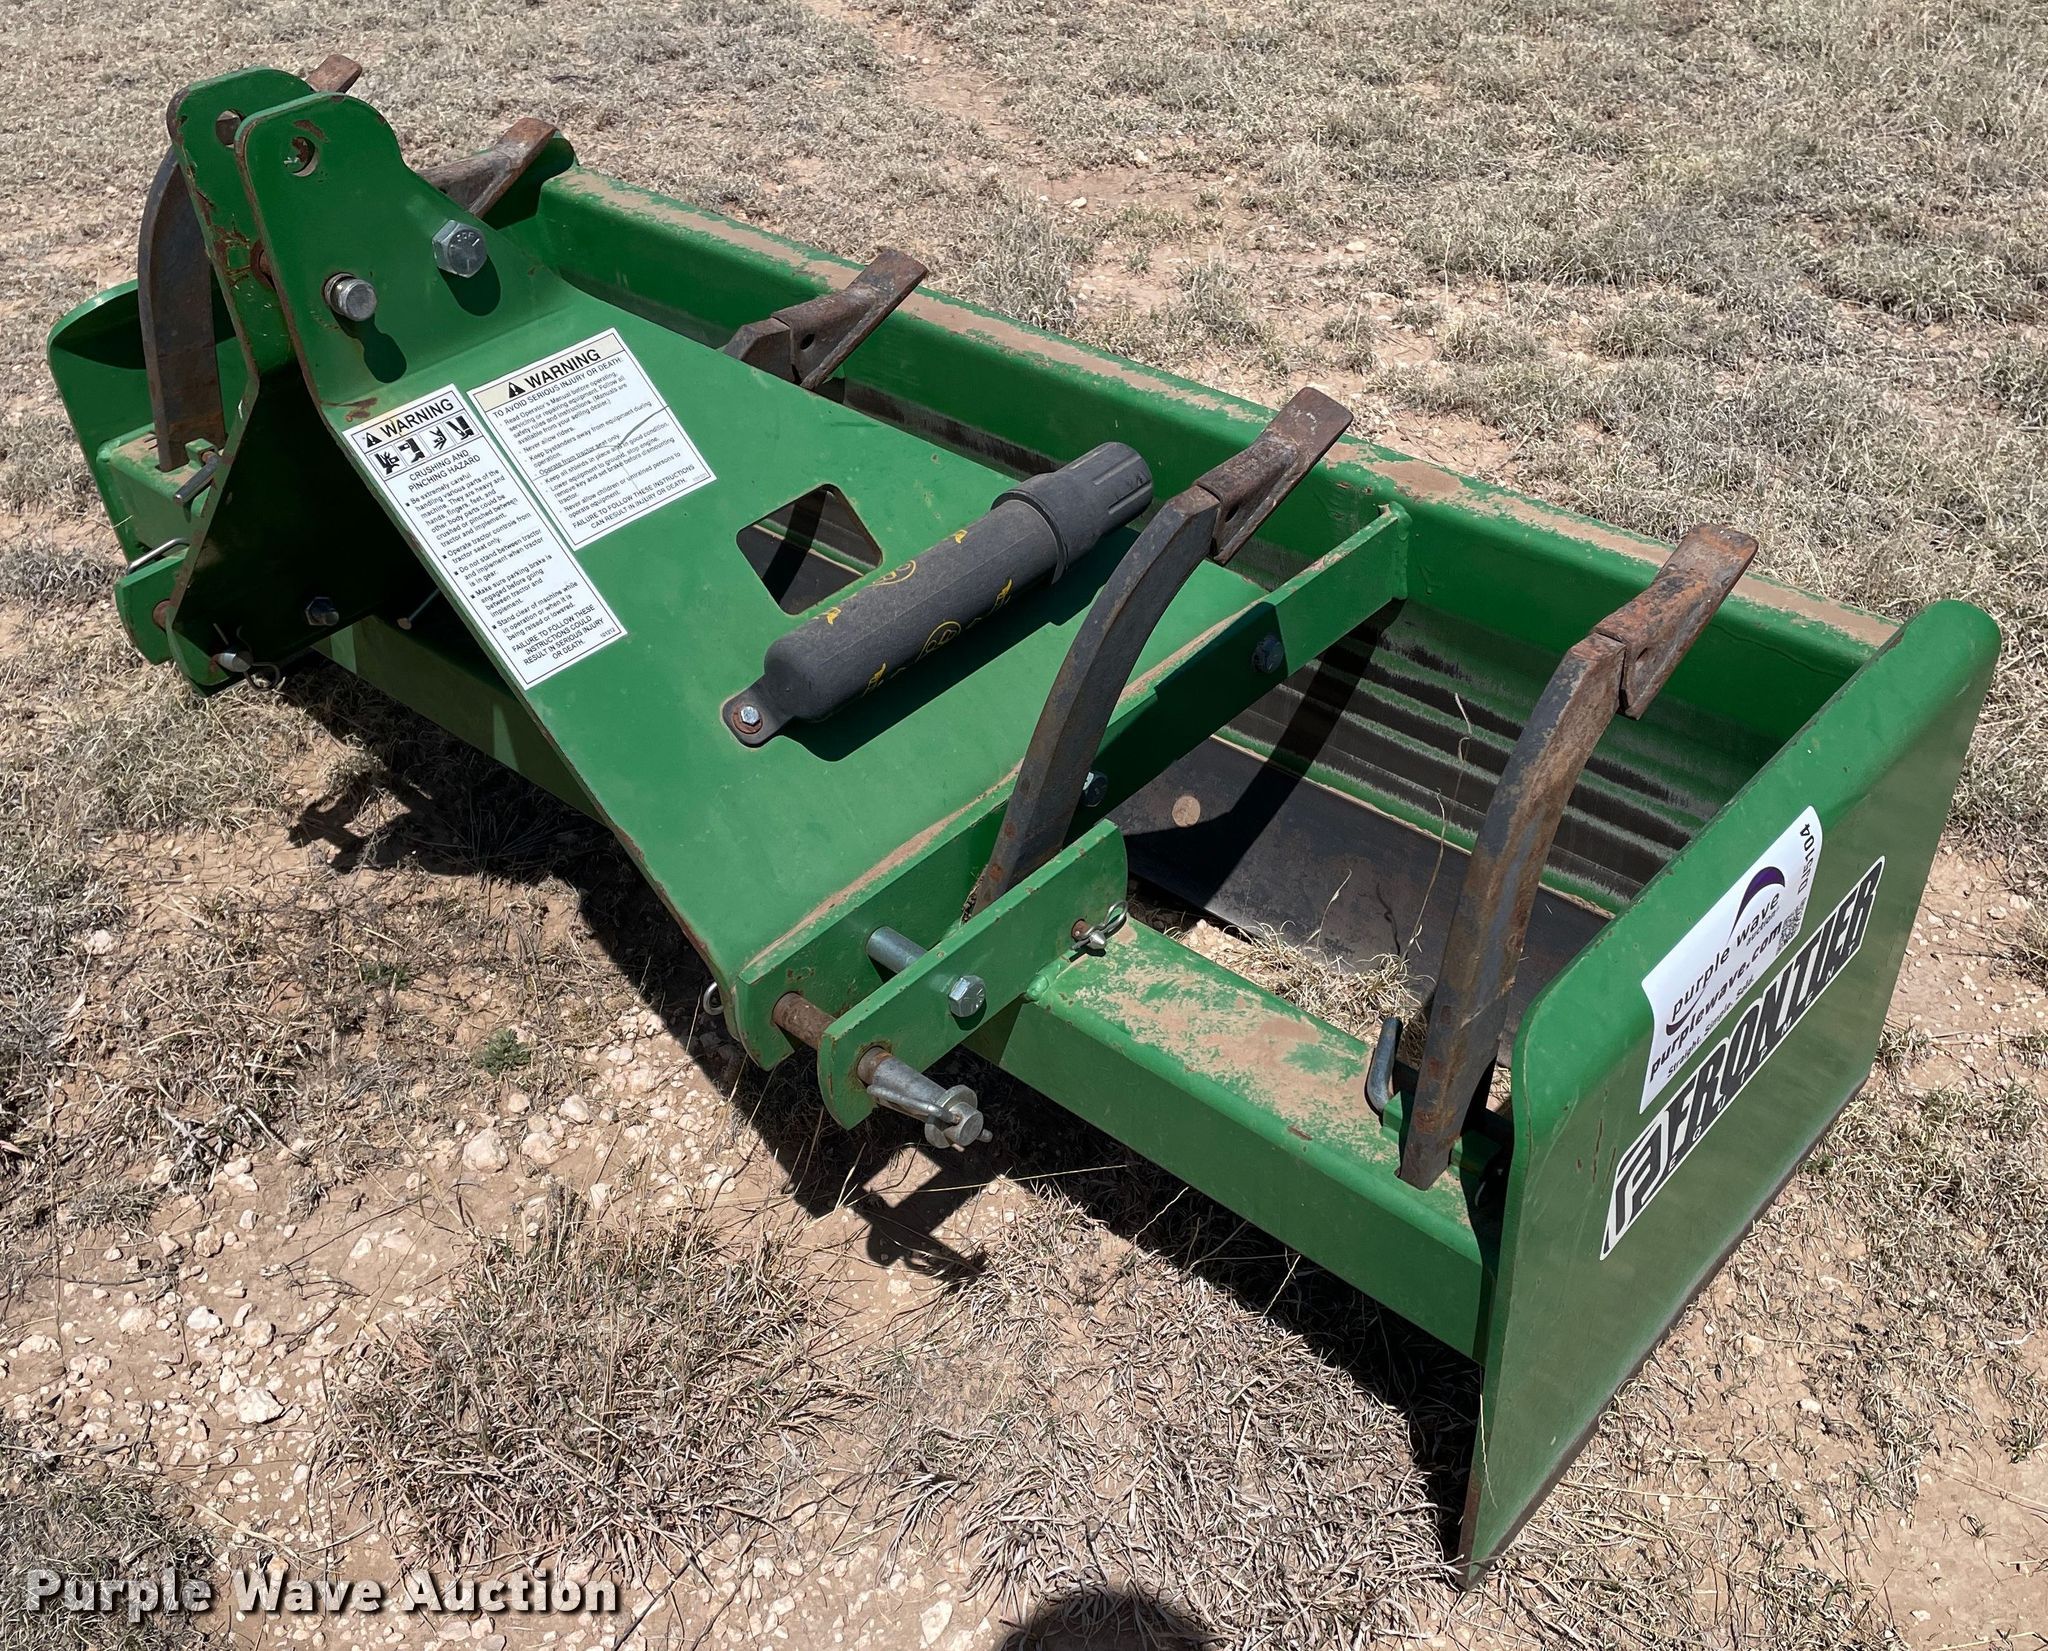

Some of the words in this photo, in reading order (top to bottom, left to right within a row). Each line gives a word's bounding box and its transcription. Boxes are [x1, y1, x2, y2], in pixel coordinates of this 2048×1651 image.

[523, 348, 601, 389] WARNING
[492, 409, 504, 418] TO
[504, 398, 527, 413] AVOID
[526, 384, 560, 403] SERIOUS
[559, 372, 586, 388] INJURY
[585, 367, 598, 376] OR
[379, 397, 454, 438] WARNING
[407, 469, 448, 492] PINCHING
[446, 454, 481, 474] HAZARD
[408, 457, 451, 481] CRUSHING
[451, 449, 469, 462] AND
[409, 496, 420, 504] Be
[419, 482, 450, 500] extremely
[449, 472, 471, 485] careful
[414, 495, 444, 512] handling
[442, 484, 466, 498] various
[465, 477, 482, 488] parts
[480, 472, 489, 480] of
[487, 468, 499, 477] the
[447, 494, 465, 505] They
[474, 480, 494, 493] heavy
[492, 474, 505, 484] and
[483, 488, 496, 498] and
[571, 511, 599, 528] FAILURE
[597, 507, 608, 515] TO
[606, 494, 633, 510] FOLLOW
[632, 484, 653, 497] THESE
[652, 464, 695, 488] INSTRUCTIONS
[590, 518, 605, 528] CAN
[603, 506, 627, 521] RESULT
[634, 492, 656, 506] INJURY
[655, 487, 666, 495] OR
[430, 521, 447, 533] other
[446, 514, 464, 525] body
[463, 506, 480, 518] parts
[479, 497, 497, 509] could
[496, 493, 505, 501] be
[435, 524, 461, 540] crushed
[468, 508, 493, 525] pinched
[492, 497, 518, 512] between
[446, 541, 472, 556] Operate
[471, 531, 492, 544] tractor
[491, 519, 517, 534] controls
[515, 511, 531, 522] from
[440, 534, 461, 547] tractor
[461, 527, 474, 537] and
[451, 550, 473, 563] tractor
[472, 543, 487, 553] seat
[458, 564, 469, 573] Do
[468, 559, 480, 568] not
[479, 550, 497, 562] stand
[496, 538, 522, 554] between
[521, 528, 541, 541] tractor
[463, 570, 477, 580] and
[475, 554, 508, 574] implement
[507, 546, 524, 558] when
[523, 536, 543, 549] tractor
[474, 584, 492, 596] Make
[491, 577, 506, 588] sure
[505, 565, 530, 581] parking
[527, 557, 546, 569] brake
[480, 586, 507, 604] engaged
[505, 576, 526, 590] before
[525, 568, 544, 581] going
[485, 594, 511, 610] between
[510, 584, 530, 597] tractor
[530, 577, 543, 587] and
[496, 613, 515, 626] Stand
[515, 606, 530, 617] clear
[529, 601, 537, 609] of
[537, 589, 562, 605] machine
[562, 581, 578, 592] while
[506, 628, 525, 641] being
[524, 618, 543, 631] raised
[508, 612, 537, 630] operation
[543, 599, 561, 611] when
[511, 634, 539, 652] FAILURE
[537, 629, 549, 637] TO
[547, 614, 575, 632] FOLLOW
[573, 603, 595, 618] THESE
[525, 626, 570, 655] INSTRUCTIONS
[569, 615, 592, 630] COULD
[523, 648, 548, 665] RESULT
[554, 629, 583, 648] SERIOUS
[581, 617, 604, 633] INJURY
[551, 650, 563, 659] OR
[1797, 822, 1815, 896] DJ5104
[1746, 911, 1776, 947] auction
[1671, 947, 1731, 1023] purple
[1736, 893, 1780, 948] wave
[1649, 921, 1783, 1084] purplewave.com
[1666, 861, 1883, 1156] FRONTIER
[1667, 1037, 1702, 1079] Straight.
[1704, 1002, 1734, 1036] Simple.
